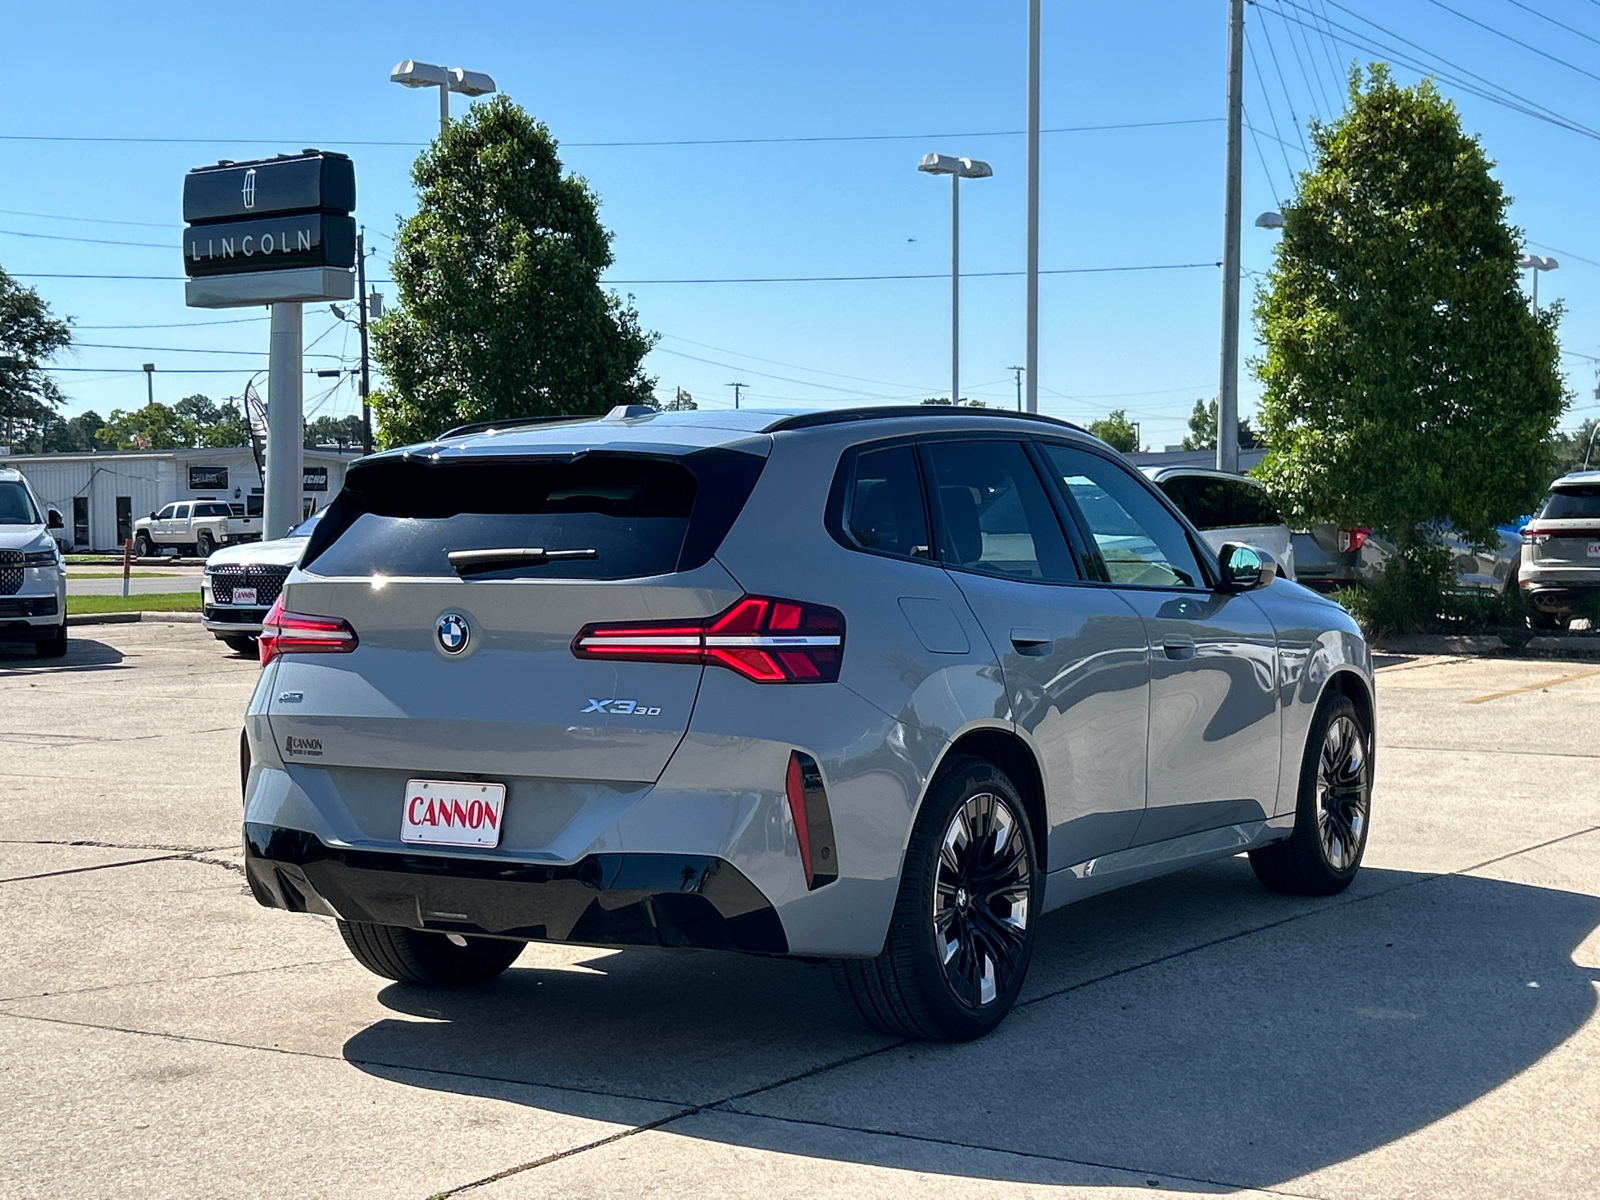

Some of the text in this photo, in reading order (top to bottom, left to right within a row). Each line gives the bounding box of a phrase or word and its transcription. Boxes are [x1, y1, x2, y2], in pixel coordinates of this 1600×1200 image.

[192, 229, 311, 262] LINCOLN
[303, 475, 326, 484] ECHO
[234, 591, 255, 599] CANNON
[293, 738, 323, 750] CANNON
[408, 796, 499, 830] CANNON
